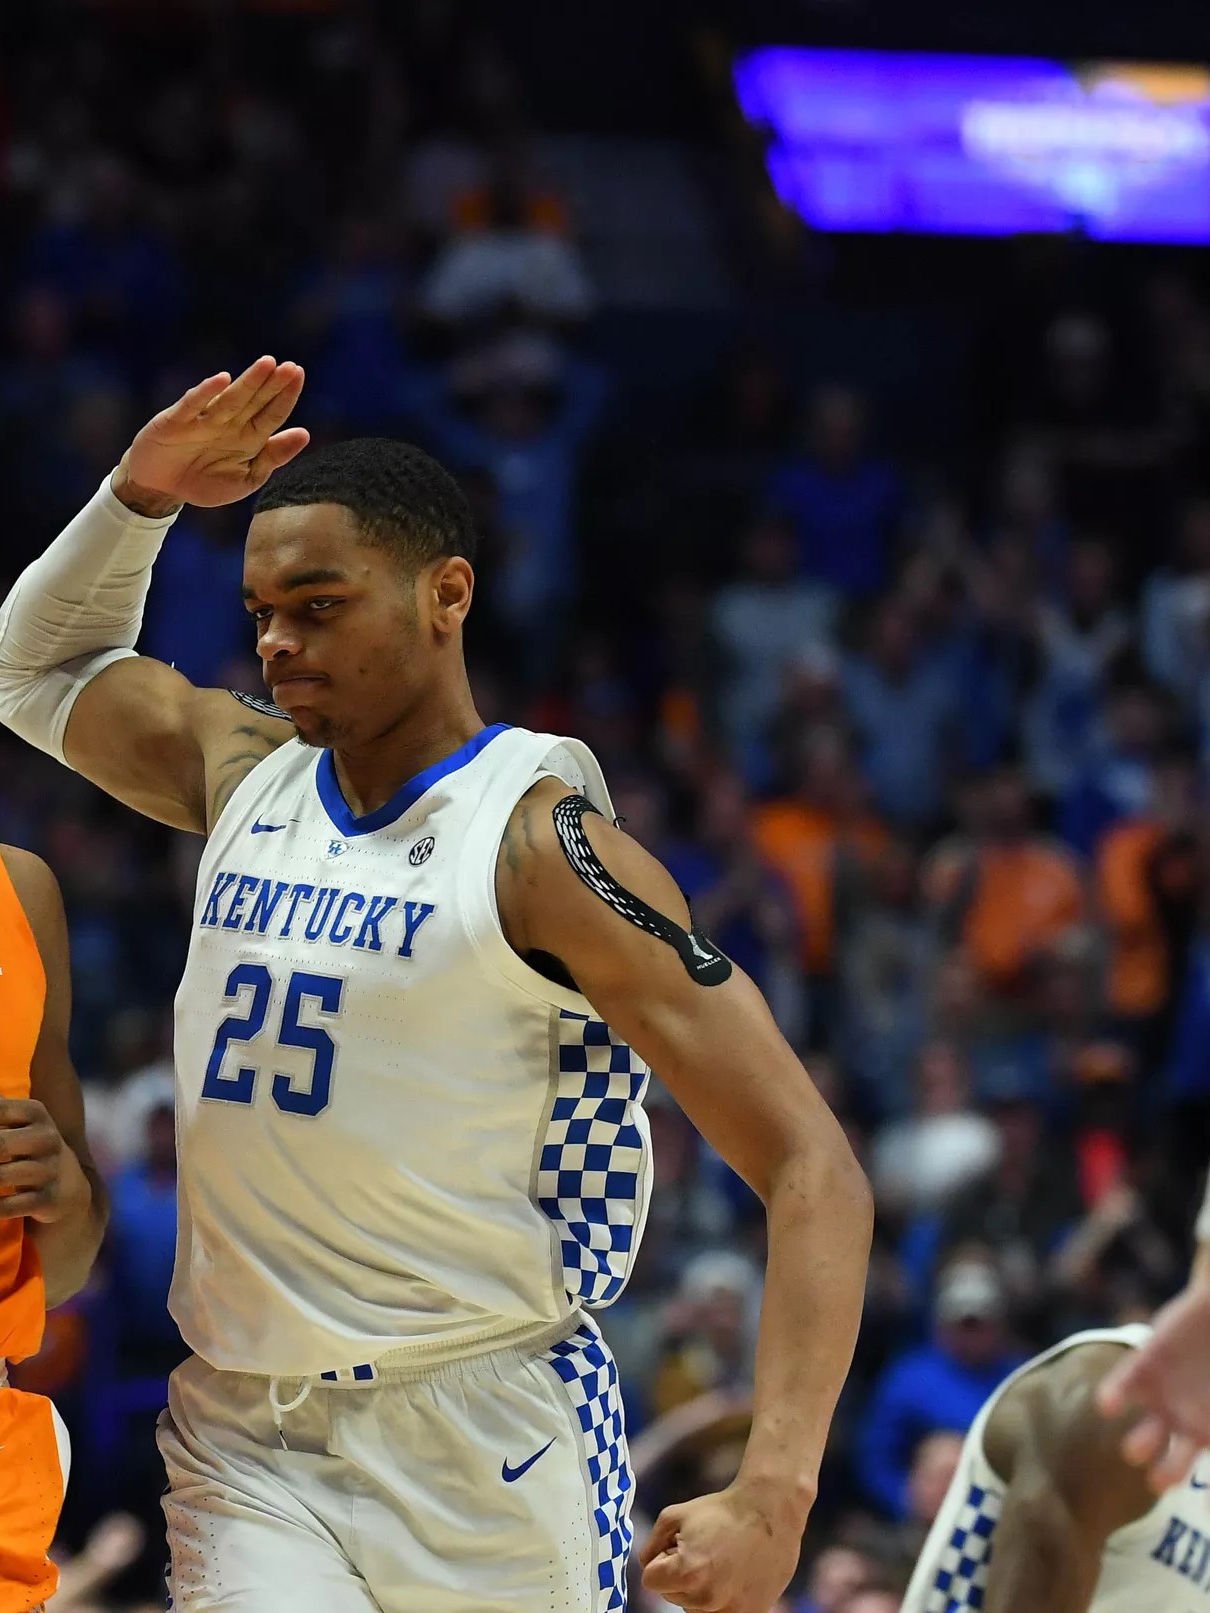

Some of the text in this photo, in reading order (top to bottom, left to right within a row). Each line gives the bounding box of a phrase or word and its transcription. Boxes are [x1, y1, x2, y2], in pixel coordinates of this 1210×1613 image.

[410, 838, 434, 864] SEC
[200, 872, 435, 959] KENTUCKY
[200, 961, 346, 1116] 25
